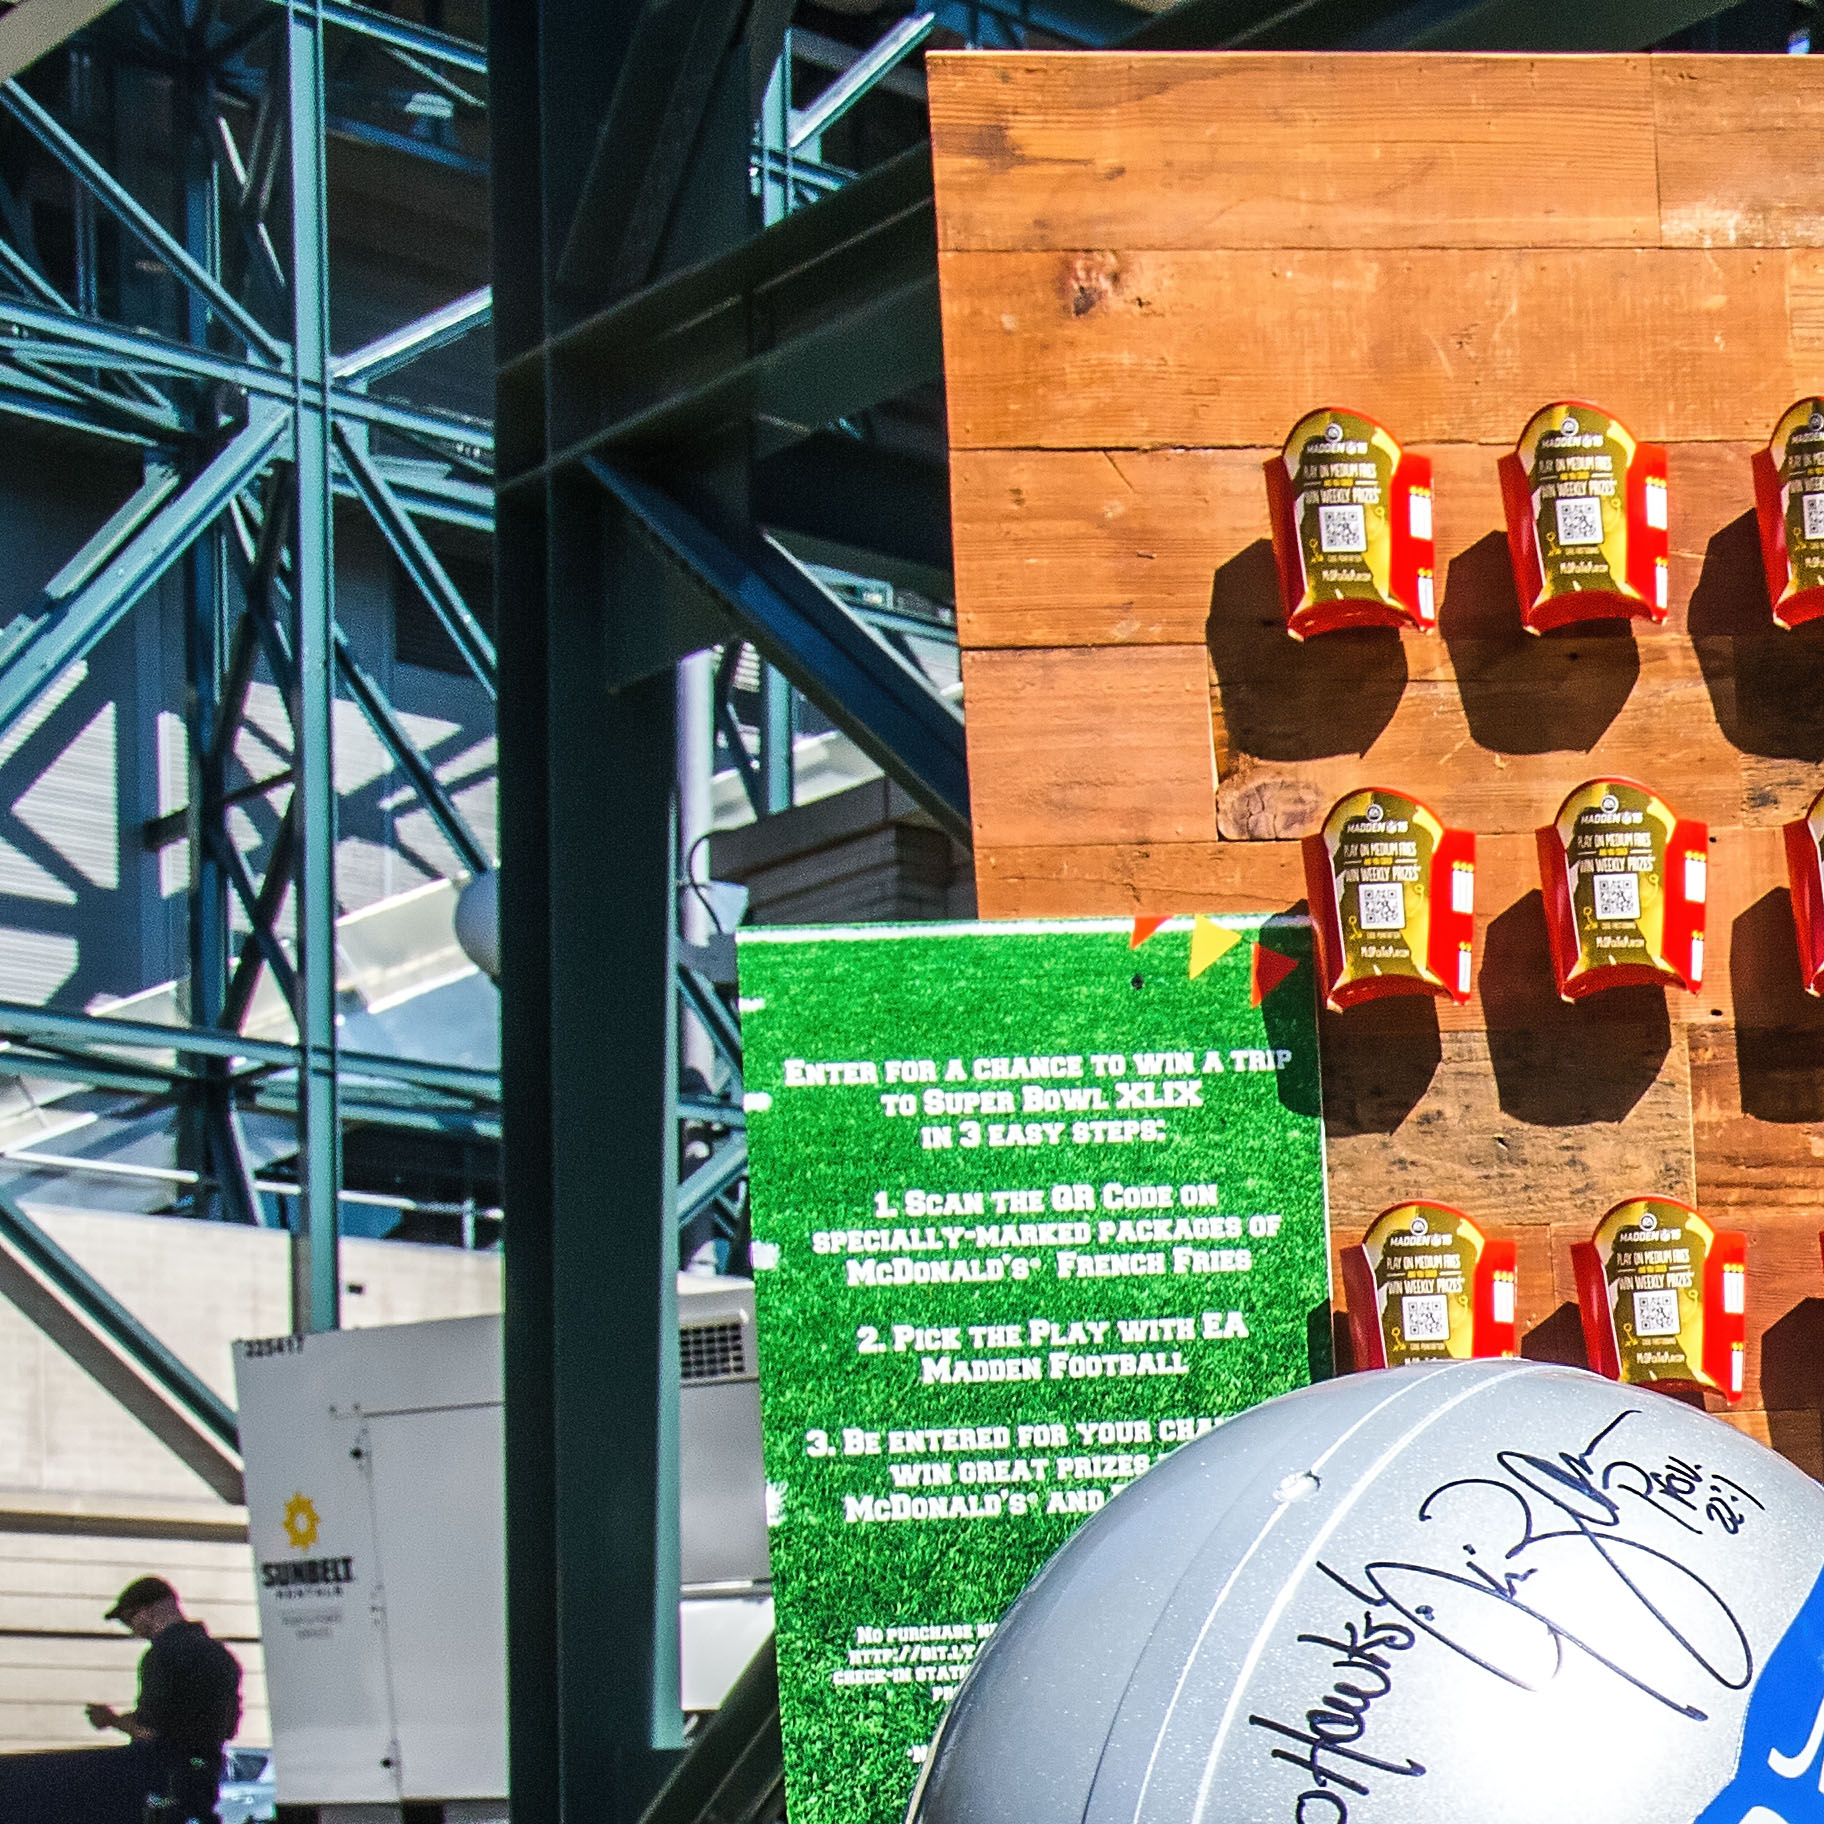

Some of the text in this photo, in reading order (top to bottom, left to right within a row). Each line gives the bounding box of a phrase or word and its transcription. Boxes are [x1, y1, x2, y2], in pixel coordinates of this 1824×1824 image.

[785, 1049, 1293, 1087] ENTER FOR A CHANCE TO WIN A TRIP
[880, 1080, 1204, 1117] TO SUPER BOWL XLIX
[921, 1119, 1167, 1150] IN 3 EASY STEPS:
[904, 1189, 985, 1217] SCAN
[990, 1190, 1046, 1214] THE
[1050, 1183, 1097, 1212] QR
[1102, 1182, 1174, 1209] CODE
[1179, 1183, 1219, 1207] ON
[811, 1214, 1283, 1254] SPECIALLY-MARKED PACKAGES OF
[1056, 1249, 1166, 1279] FRENCH
[1172, 1246, 1253, 1274] FRIES
[856, 1311, 1250, 1355] 2. PICK THE PLAY WITH EA
[920, 1351, 1190, 1385] MADDEN FOOTBALL
[806, 1416, 1226, 1458] 3. BE ENTERED FOR YOUR CHA
[889, 1462, 952, 1489] WIN
[958, 1458, 1051, 1485] GREAT
[1057, 1454, 1150, 1481] PRIZES
[1046, 1488, 1105, 1514] AND
[261, 1556, 353, 1587] SUNBELT
[856, 1625, 884, 1644] NO
[886, 1623, 974, 1643] PURCHASE
